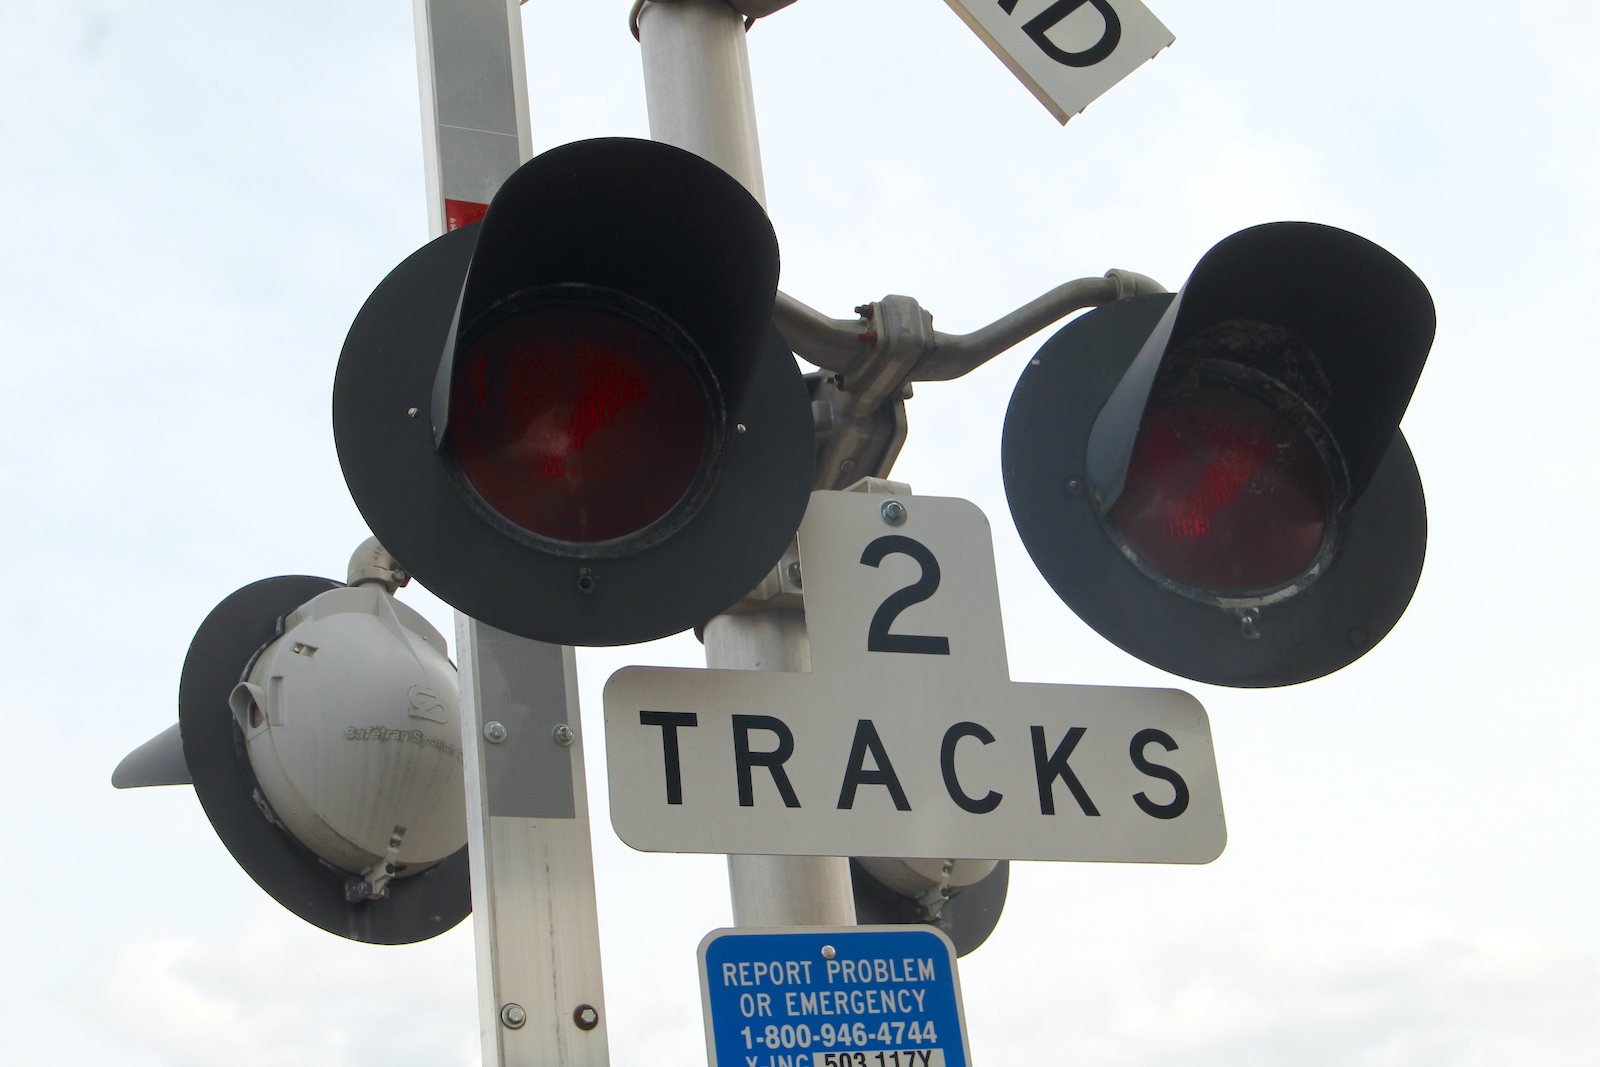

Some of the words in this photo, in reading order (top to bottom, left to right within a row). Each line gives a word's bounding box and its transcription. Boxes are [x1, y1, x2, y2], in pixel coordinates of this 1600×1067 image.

[860, 534, 950, 656] 2
[344, 725, 410, 744] Safetran
[639, 710, 1191, 820] TRACKS
[722, 961, 813, 987] REPORT
[826, 957, 937, 984] PROBLEM
[739, 993, 773, 1018] OR
[785, 988, 926, 1017] EMERGENCY
[740, 1020, 938, 1050] 1-800-946-4744
[824, 1052, 867, 1067] 503
[874, 1049, 933, 1067] 117Y
